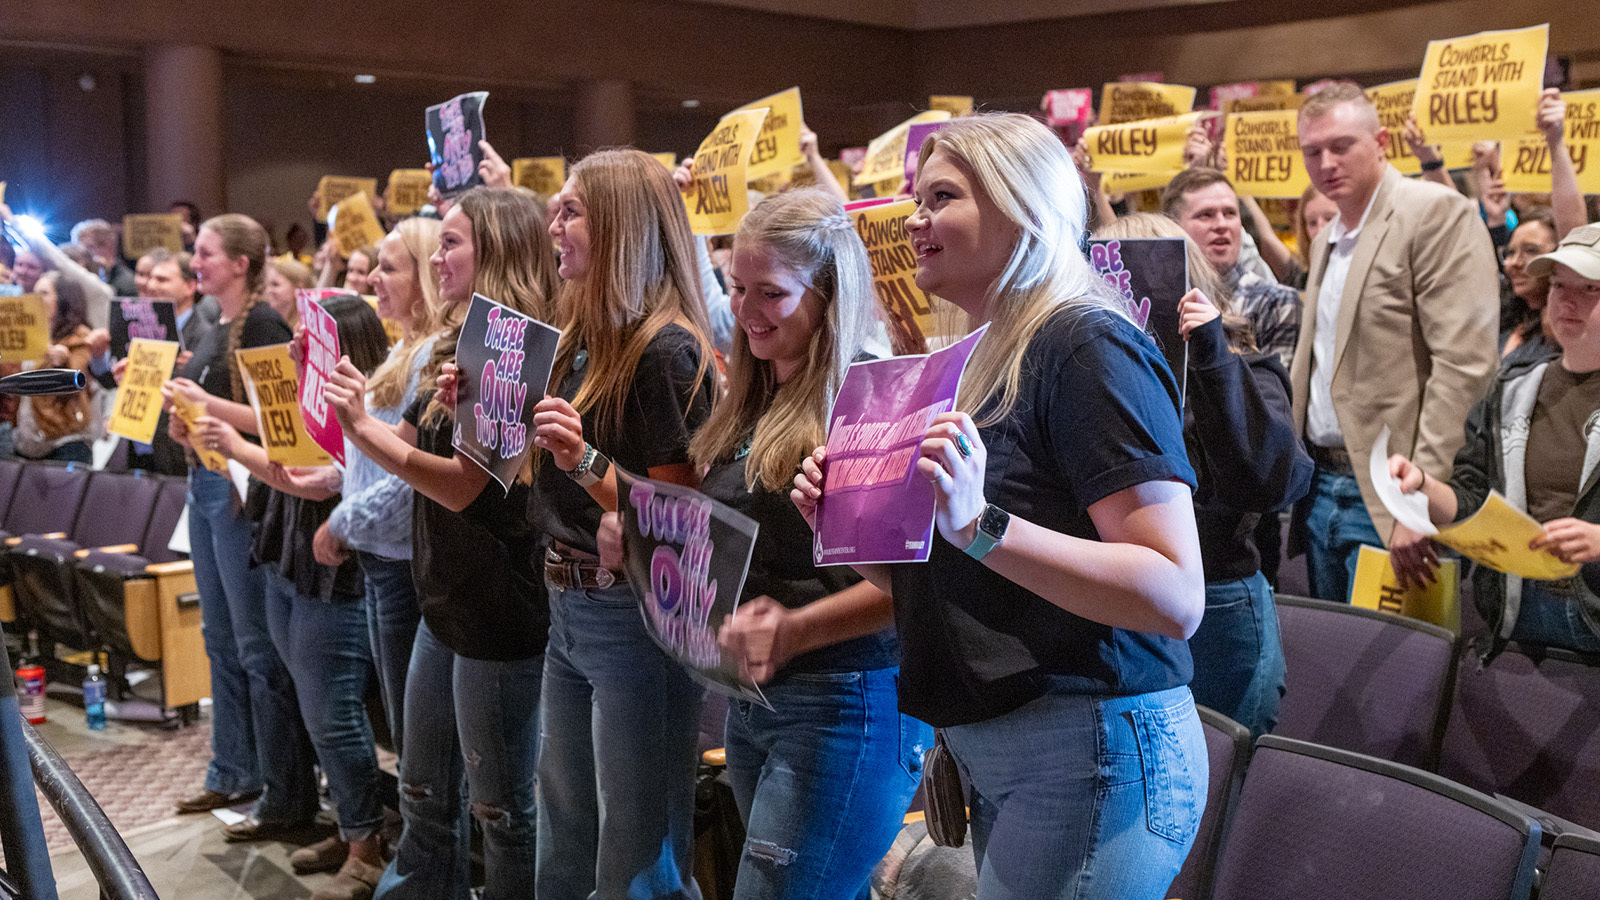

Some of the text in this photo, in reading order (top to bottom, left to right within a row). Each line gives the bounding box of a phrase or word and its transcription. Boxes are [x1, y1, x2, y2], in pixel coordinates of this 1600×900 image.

[1439, 43, 1509, 67] COWGIRLS
[1433, 60, 1525, 90] STAND WITH
[1429, 89, 1498, 126] RILEY
[1097, 128, 1158, 156] RILEY
[1235, 117, 1291, 136] COWGIRLS
[1571, 121, 1600, 138] WIT
[749, 136, 777, 166] LEY
[1513, 143, 1587, 175] RILY
[1235, 156, 1291, 182] RILEY
[695, 174, 732, 214] RILEY
[485, 306, 528, 352] THERE
[496, 350, 525, 383] ARE
[480, 359, 527, 425] ONLY
[262, 409, 297, 446] LEY
[474, 403, 498, 450] TWO
[501, 422, 526, 459] SEXES
